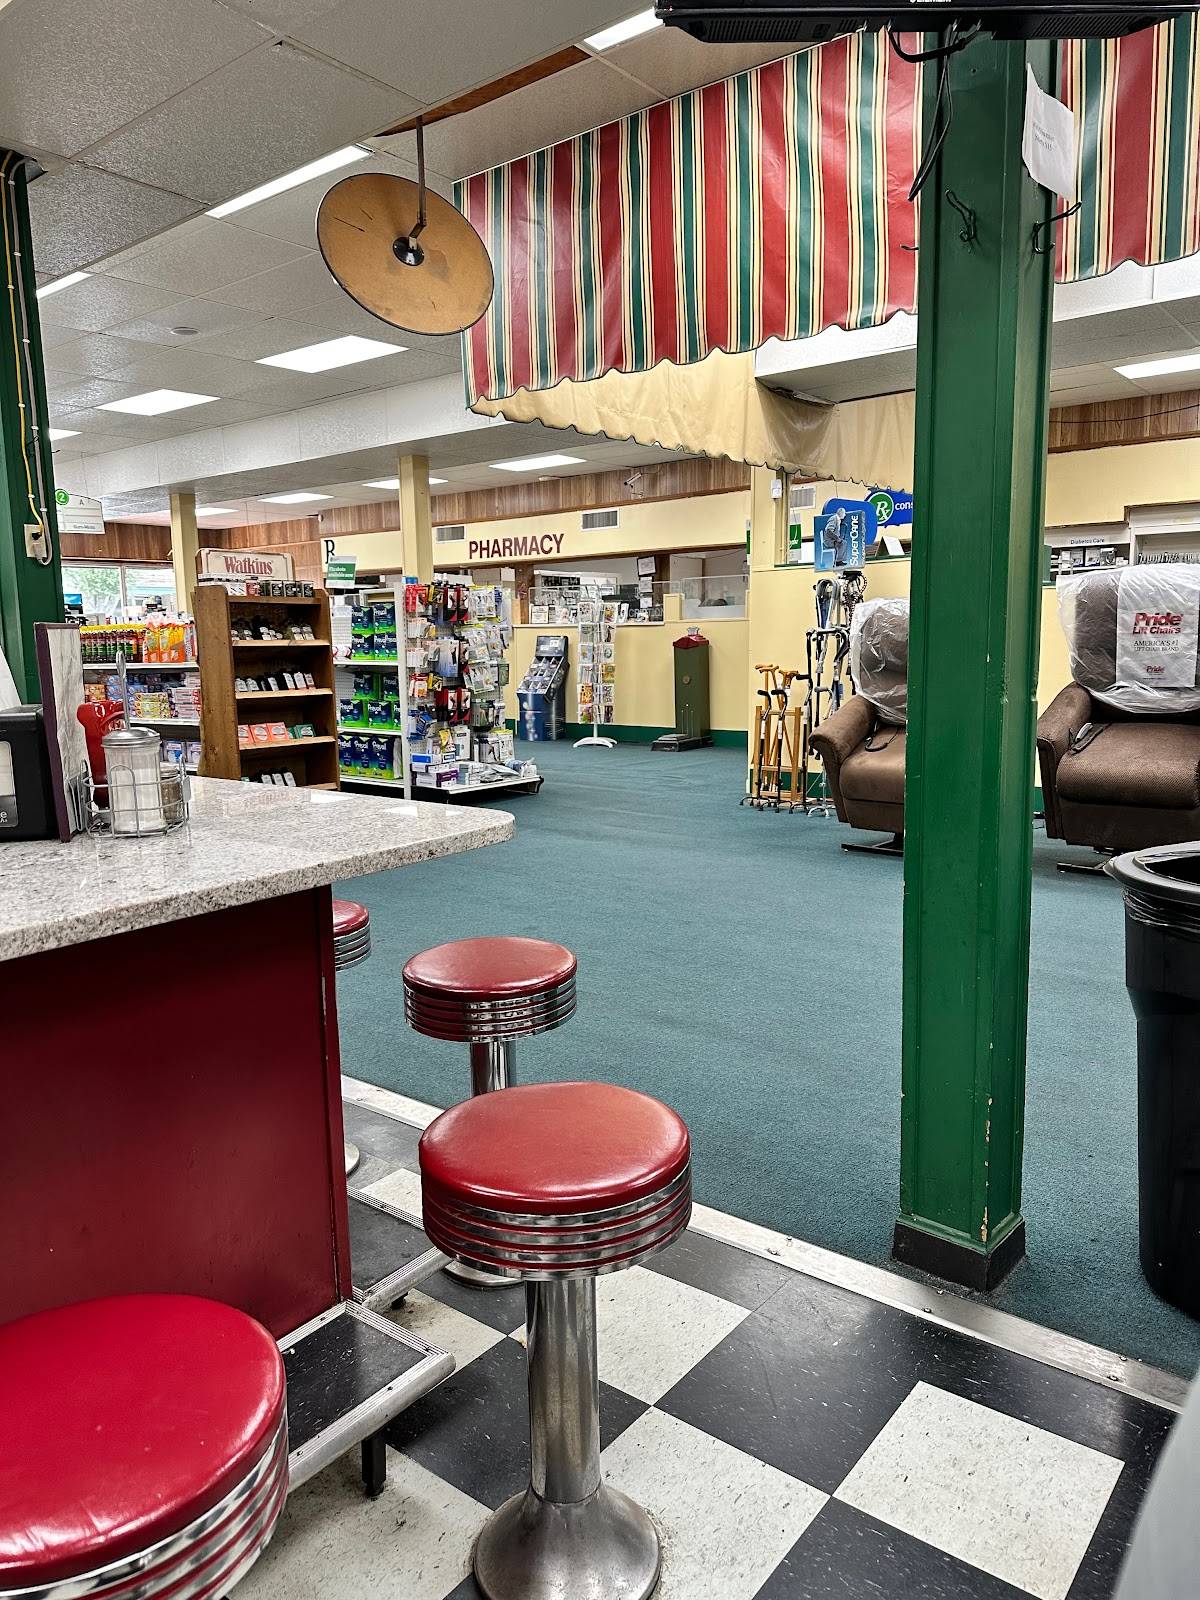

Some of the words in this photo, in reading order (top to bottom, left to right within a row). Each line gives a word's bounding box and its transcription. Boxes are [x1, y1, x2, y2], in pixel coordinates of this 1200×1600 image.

[58, 492, 66, 502] 2
[469, 533, 565, 559] PHARMACY
[223, 555, 273, 575] Watkins
[1133, 612, 1183, 626] Pride
[1132, 626, 1148, 635] Lift
[1149, 626, 1181, 635] Chairs
